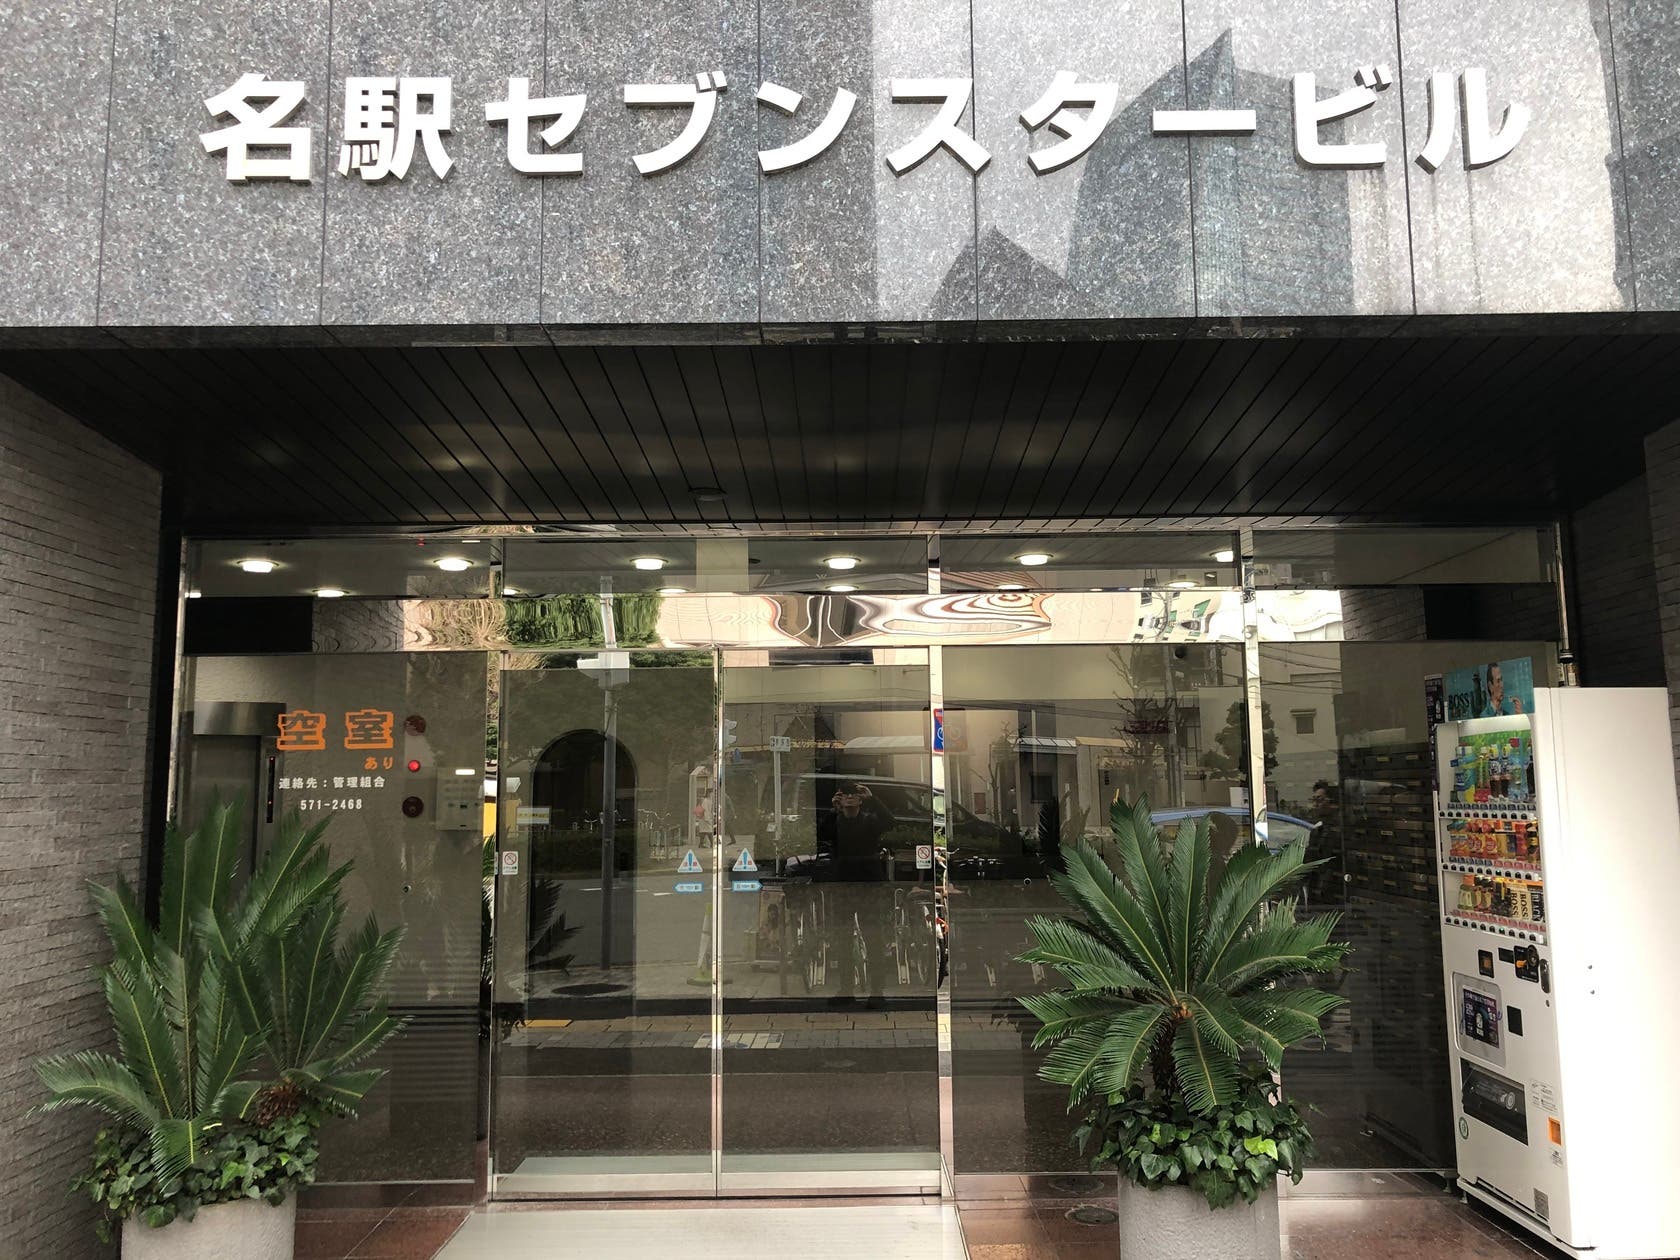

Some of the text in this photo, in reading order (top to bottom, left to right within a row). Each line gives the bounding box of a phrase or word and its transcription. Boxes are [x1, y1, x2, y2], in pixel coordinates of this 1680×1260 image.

[199, 66, 1531, 184] 名駅セブンスタービル
[276, 709, 394, 751] 空室
[364, 757, 394, 770] あり
[300, 799, 363, 810] 571-2468
[1511, 893, 1519, 916] BOSS
[1520, 894, 1529, 918] BOSS
